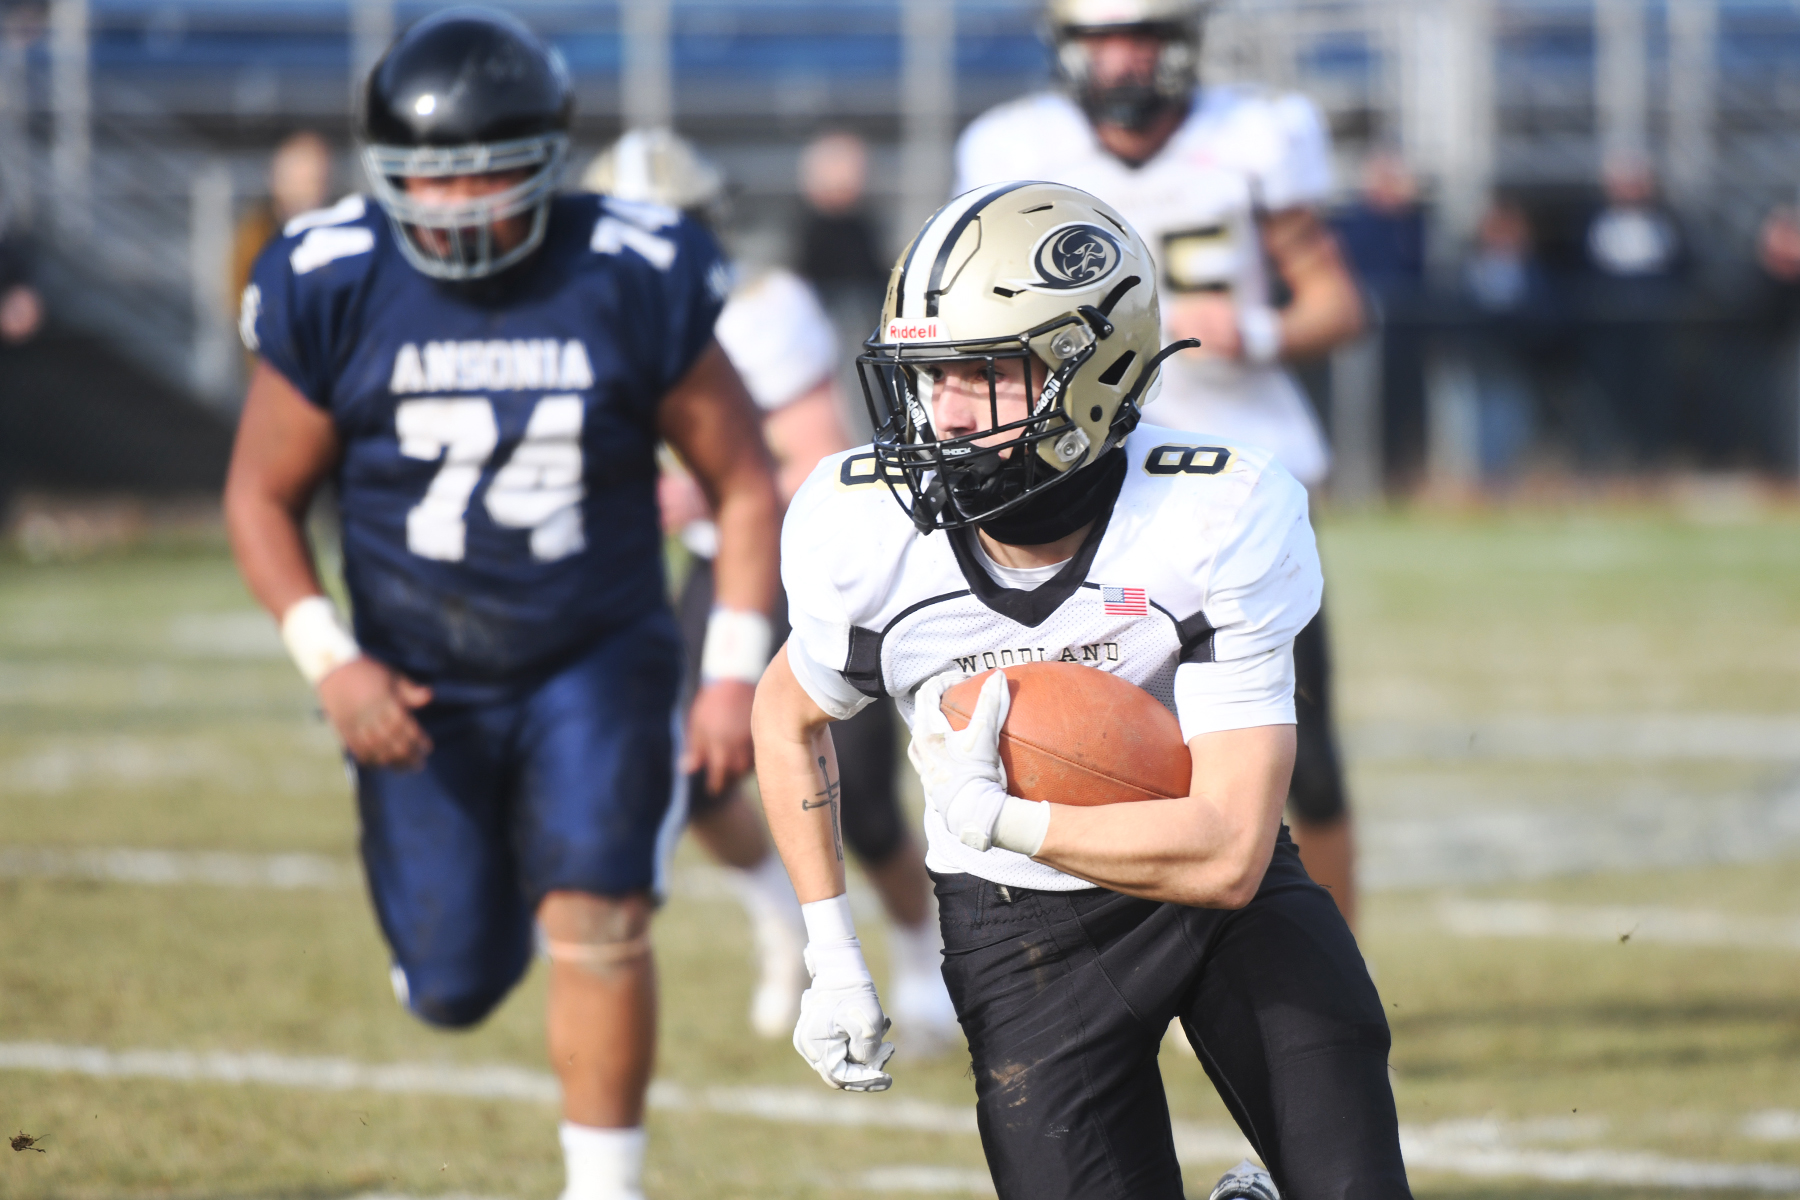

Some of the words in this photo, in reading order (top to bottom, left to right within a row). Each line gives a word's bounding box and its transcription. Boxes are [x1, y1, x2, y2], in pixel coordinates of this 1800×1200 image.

[890, 324, 937, 339] Riddell
[391, 338, 594, 393] ANSONIA
[395, 393, 588, 564] 74
[1142, 443, 1239, 477] 8
